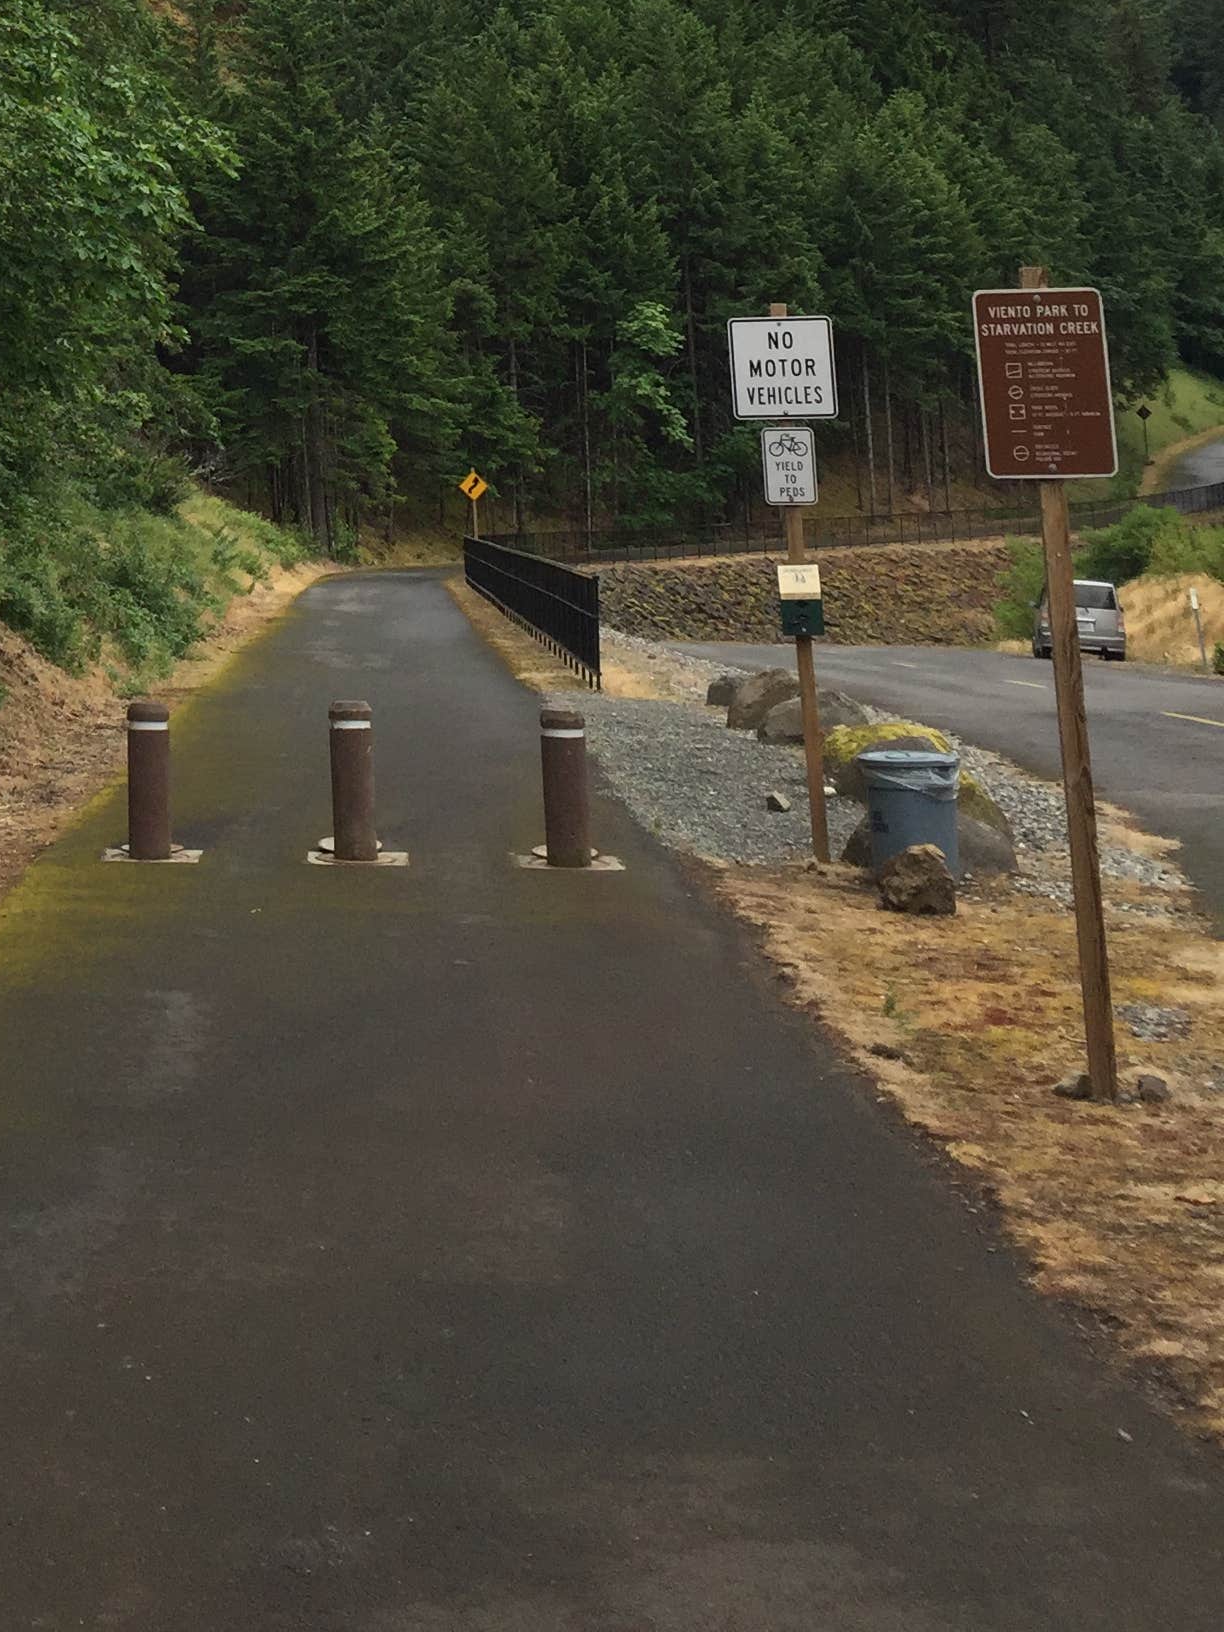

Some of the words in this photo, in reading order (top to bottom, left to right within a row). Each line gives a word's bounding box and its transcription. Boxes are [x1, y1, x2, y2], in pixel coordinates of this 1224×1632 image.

[988, 305, 1031, 319] VIENTO
[1036, 304, 1069, 317] PARK
[1073, 303, 1089, 317] TO
[981, 322, 1054, 337] STARVATION
[1059, 321, 1099, 335] CREEK
[767, 331, 794, 350] NO
[749, 358, 817, 378] MOTOR
[746, 386, 823, 406] VEHICLES
[776, 460, 804, 472] YIELD
[784, 473, 797, 485] TO
[779, 486, 806, 498] PEDS
